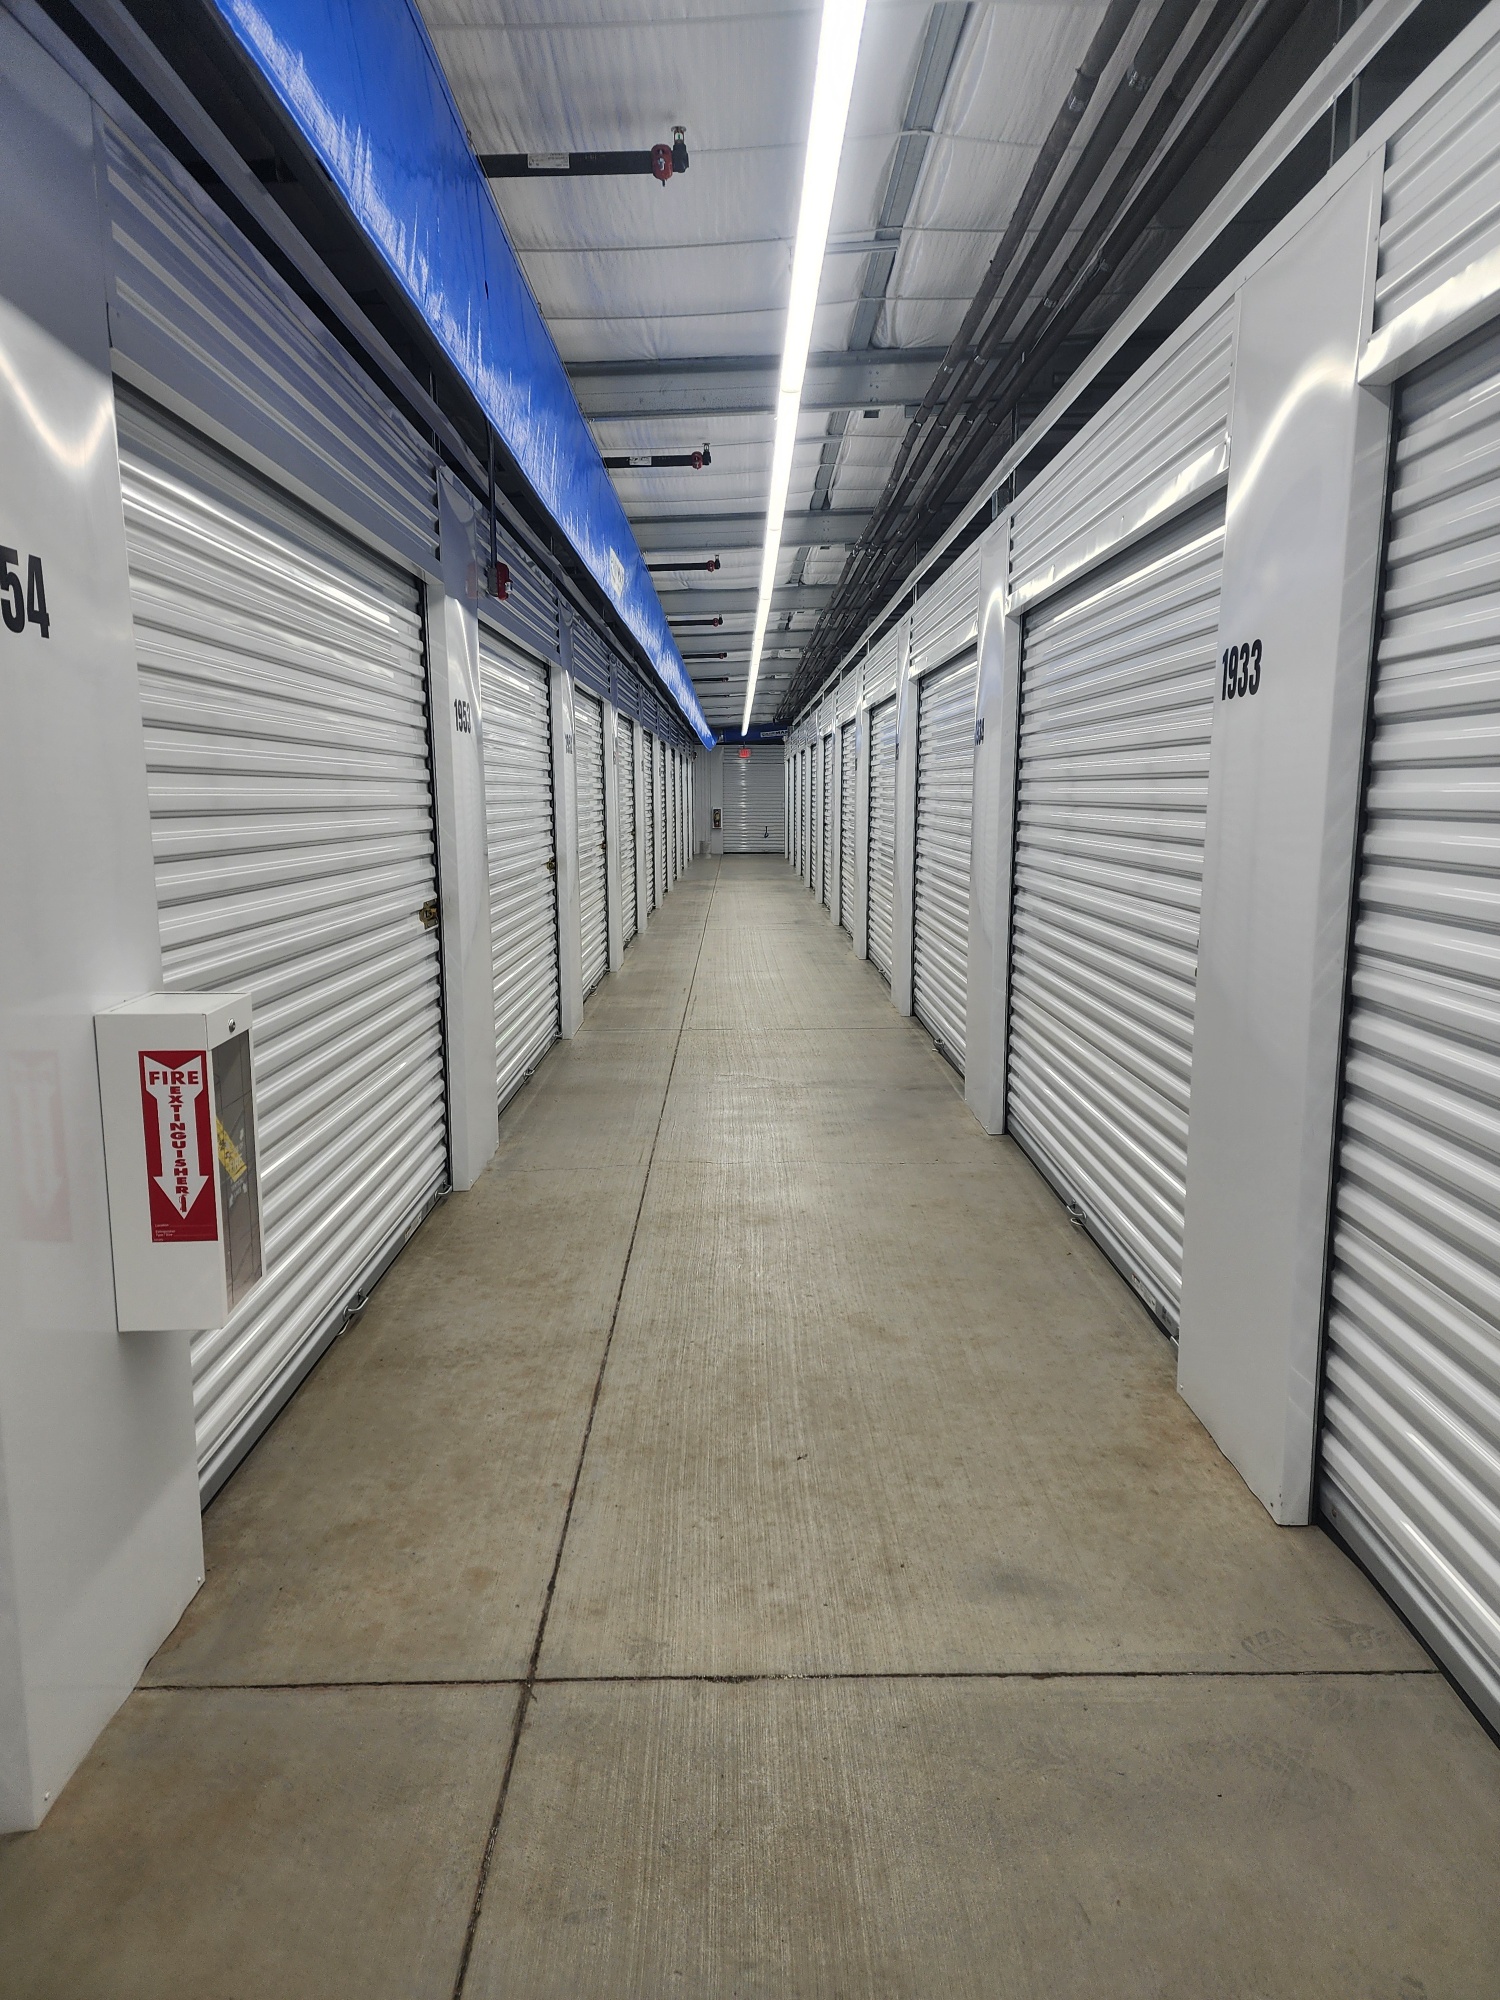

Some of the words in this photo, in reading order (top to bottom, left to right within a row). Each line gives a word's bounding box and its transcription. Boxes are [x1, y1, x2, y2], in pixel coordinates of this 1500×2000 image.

[1222, 638, 1262, 701] 1933
[454, 698, 471, 734] 1953
[149, 1071, 199, 1085] FIRE
[168, 1086, 190, 1194] EXTINGUISHER
